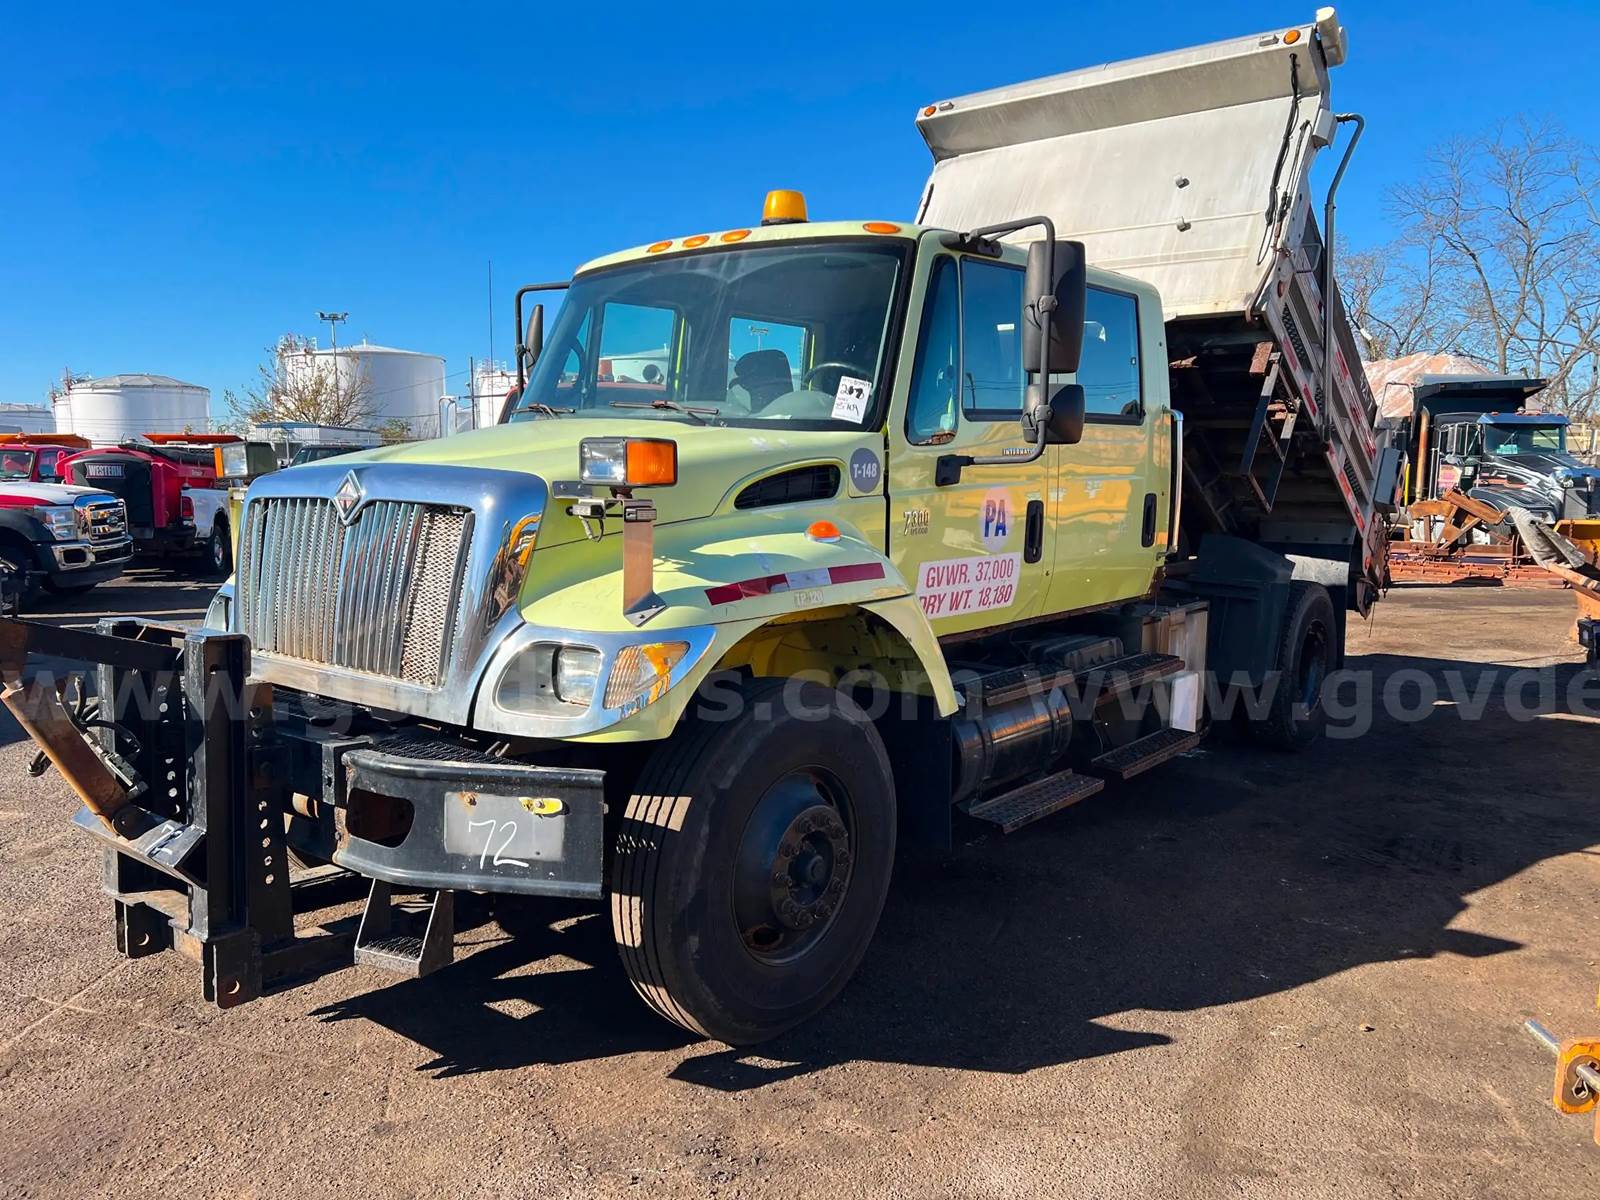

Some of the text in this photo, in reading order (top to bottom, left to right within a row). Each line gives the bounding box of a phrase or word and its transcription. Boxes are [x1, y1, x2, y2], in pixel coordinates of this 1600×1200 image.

[88, 464, 122, 477] WESTERN
[853, 463, 877, 479] T-148
[984, 499, 1007, 537] PA
[926, 558, 1014, 589] GVWR. 37,000
[949, 589, 971, 612] WT.
[978, 583, 1013, 608] 18,180
[468, 819, 530, 870] 72
